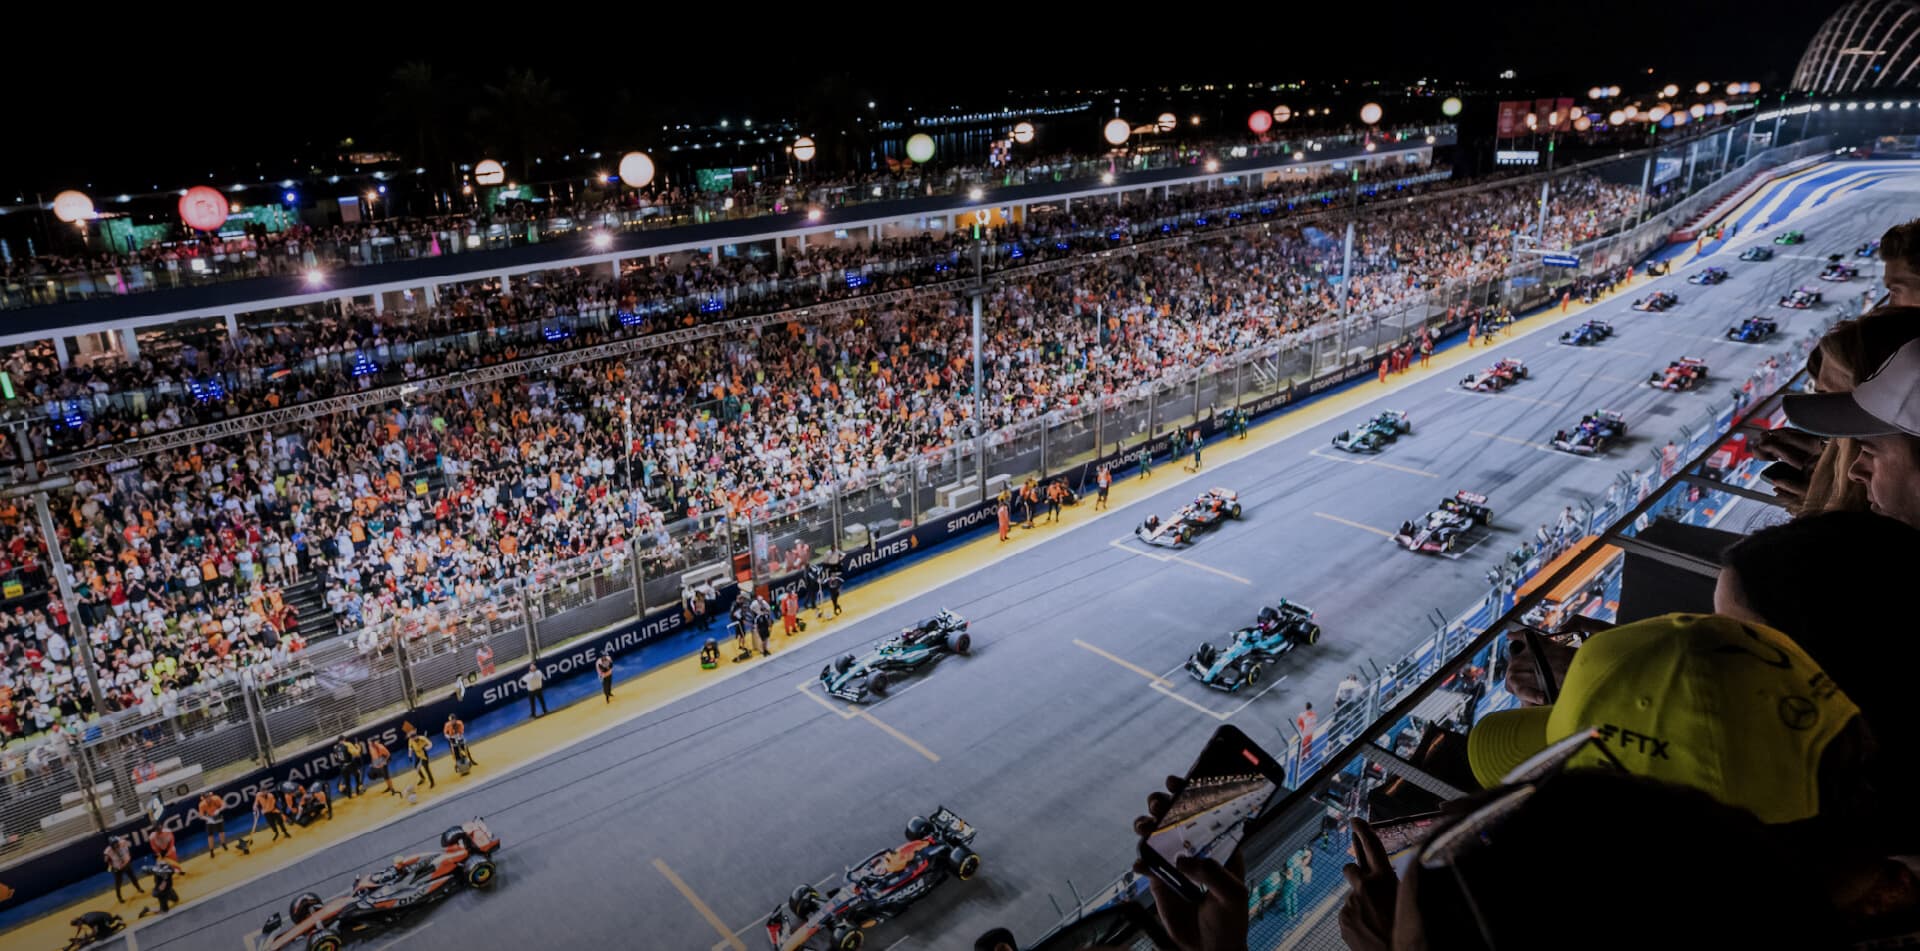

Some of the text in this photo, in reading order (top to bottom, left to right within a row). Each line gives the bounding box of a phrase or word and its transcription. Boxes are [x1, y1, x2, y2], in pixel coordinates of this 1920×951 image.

[848, 538, 908, 572] AIRLINES
[604, 613, 681, 653] AIRLINES
[1621, 729, 1669, 760] FTX
